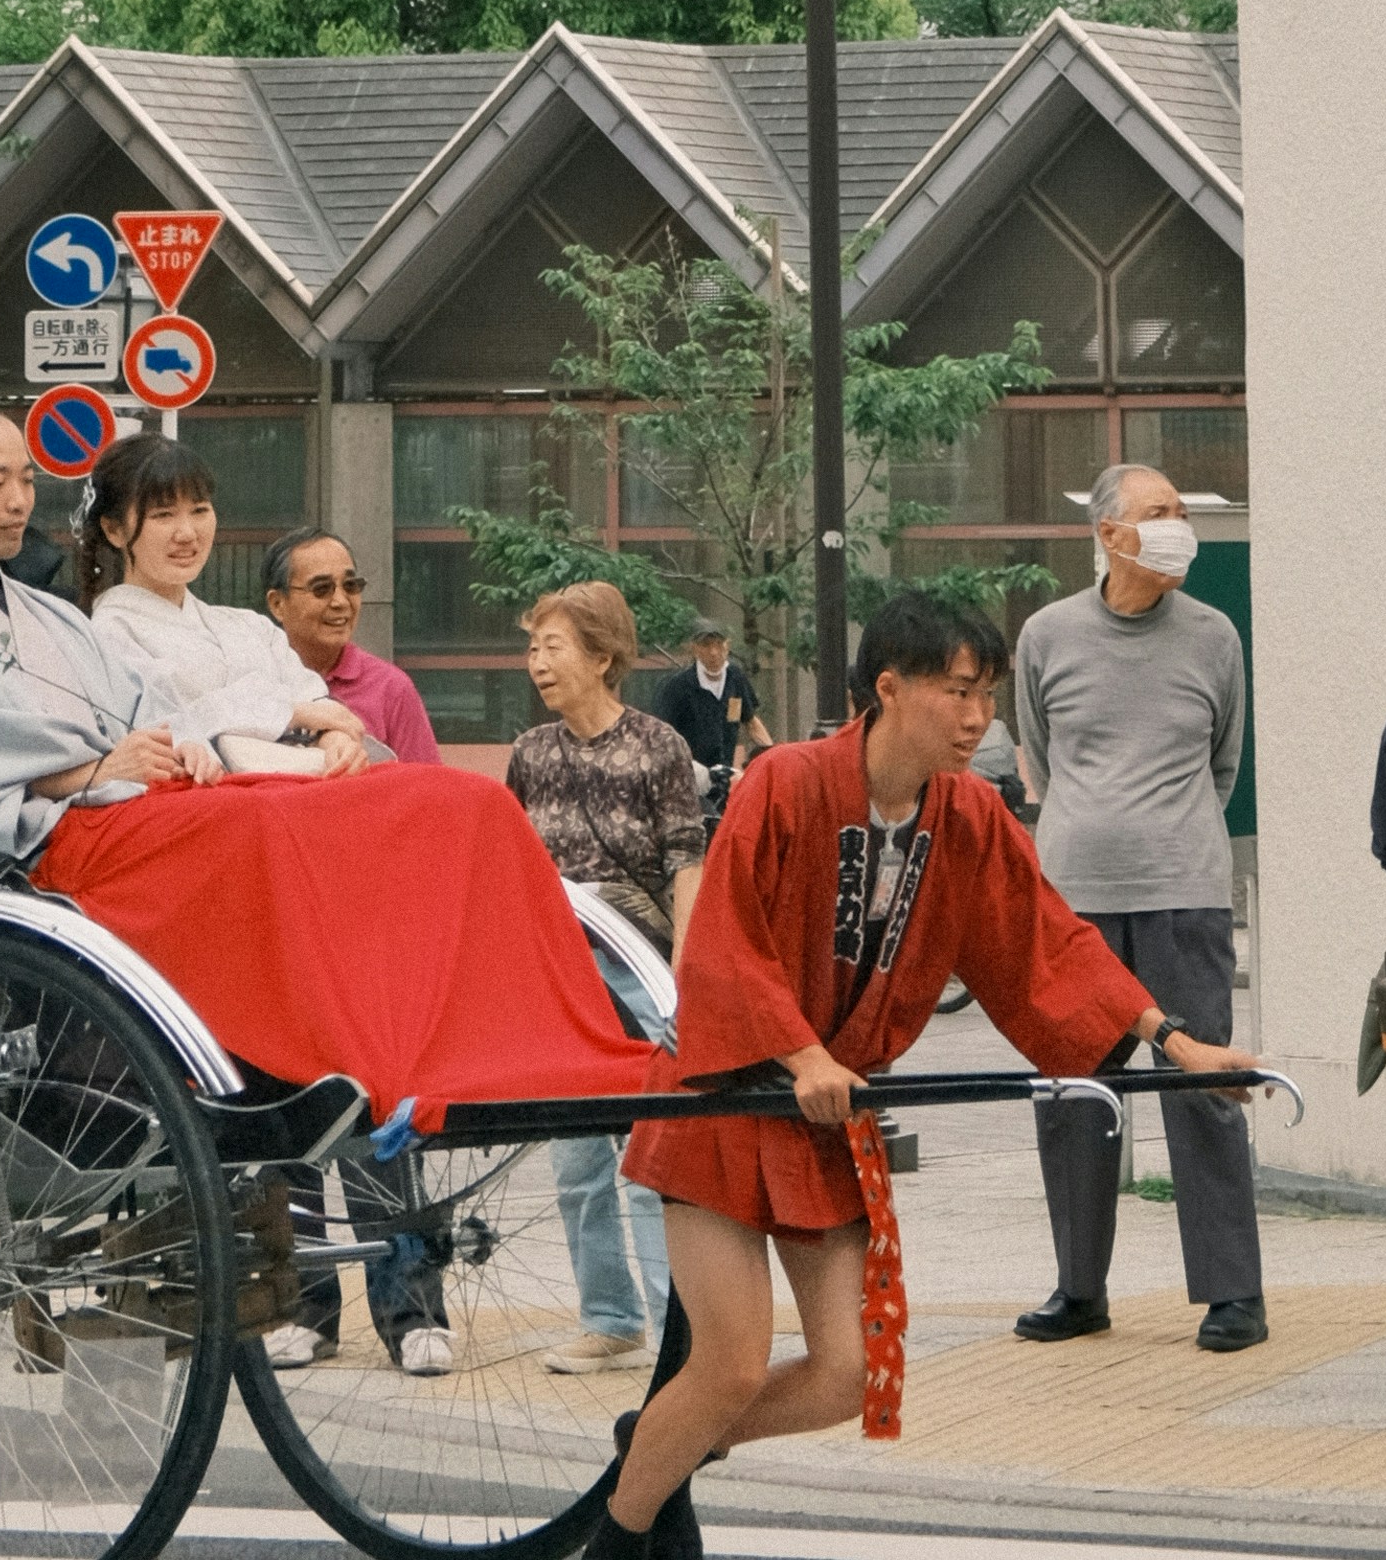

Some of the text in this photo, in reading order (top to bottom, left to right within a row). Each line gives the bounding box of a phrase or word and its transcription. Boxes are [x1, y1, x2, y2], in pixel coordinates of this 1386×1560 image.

[137, 224, 202, 247] 止まれ
[148, 251, 193, 270] STOP
[33, 319, 108, 336] 自転車を除く
[32, 339, 109, 356] 一方通行
